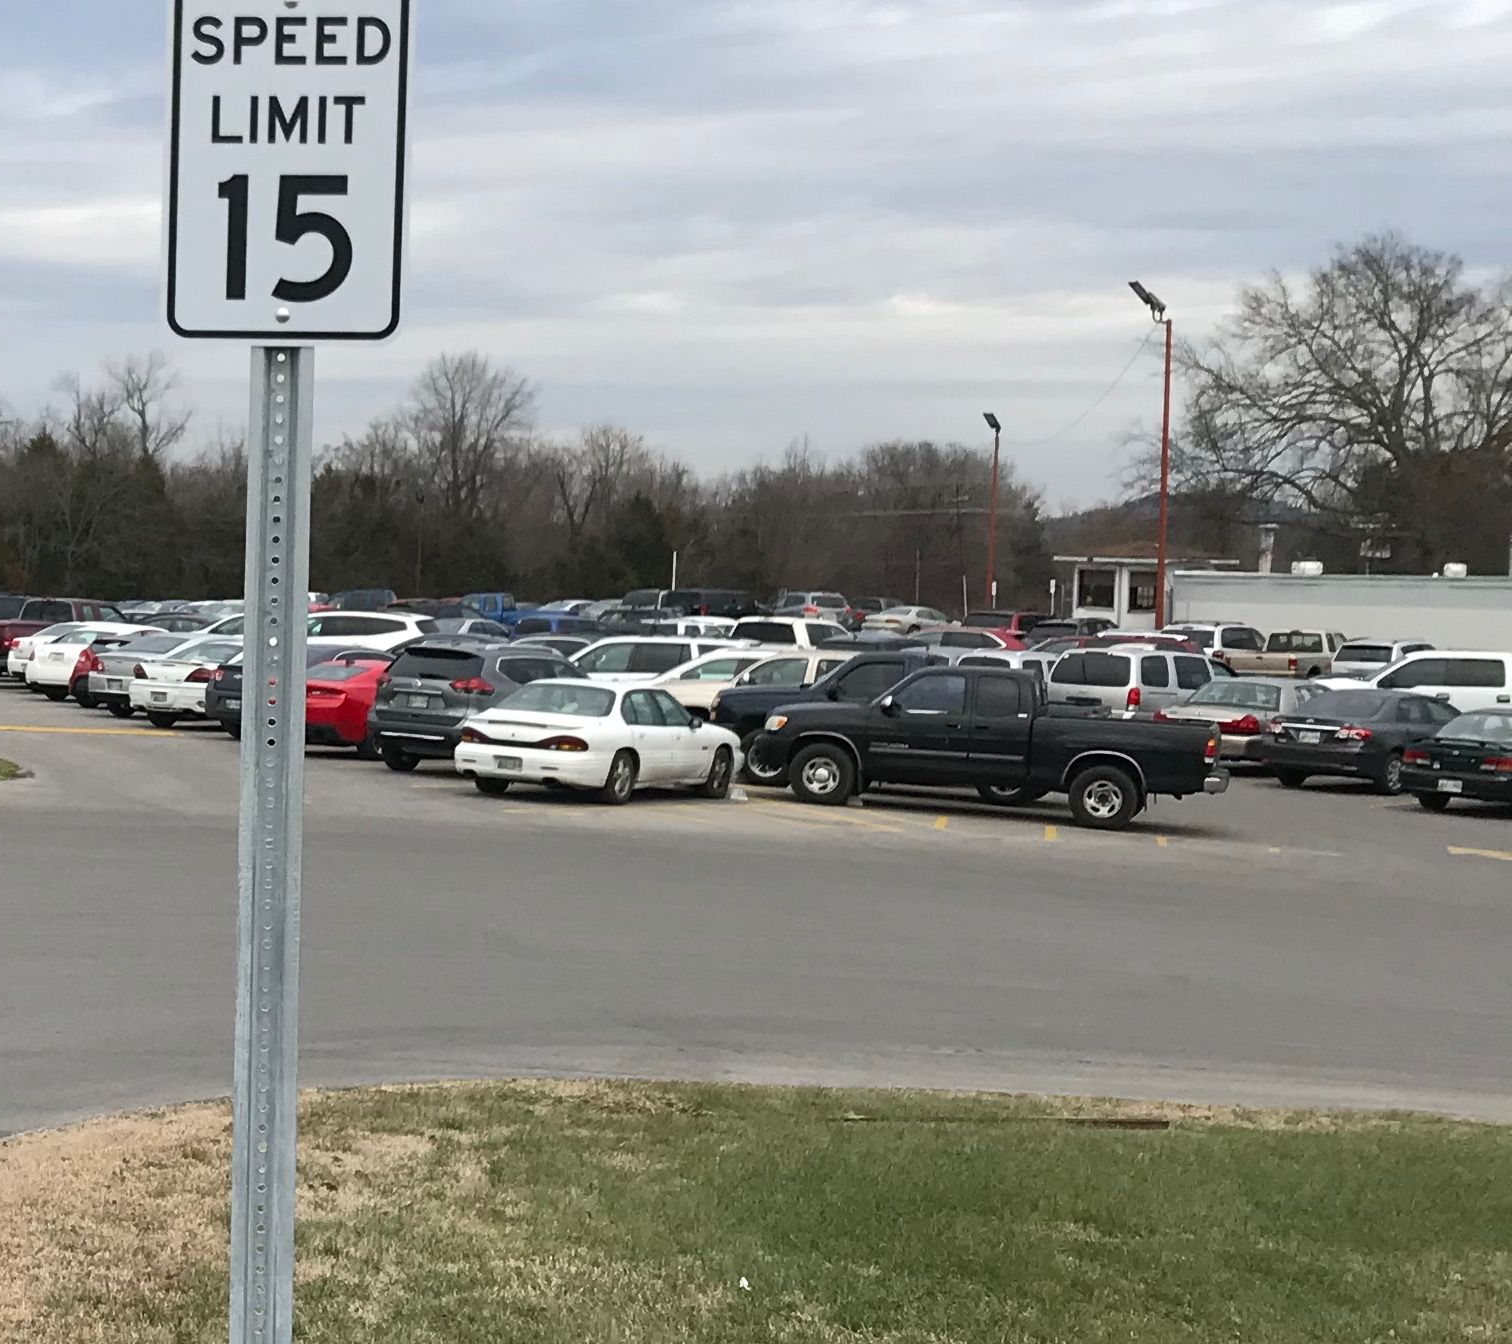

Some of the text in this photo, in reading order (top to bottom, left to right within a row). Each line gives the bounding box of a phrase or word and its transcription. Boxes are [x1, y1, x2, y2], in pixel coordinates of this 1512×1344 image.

[190, 16, 392, 65] SPEED
[211, 95, 366, 145] LIMIT
[217, 173, 353, 303] 15
